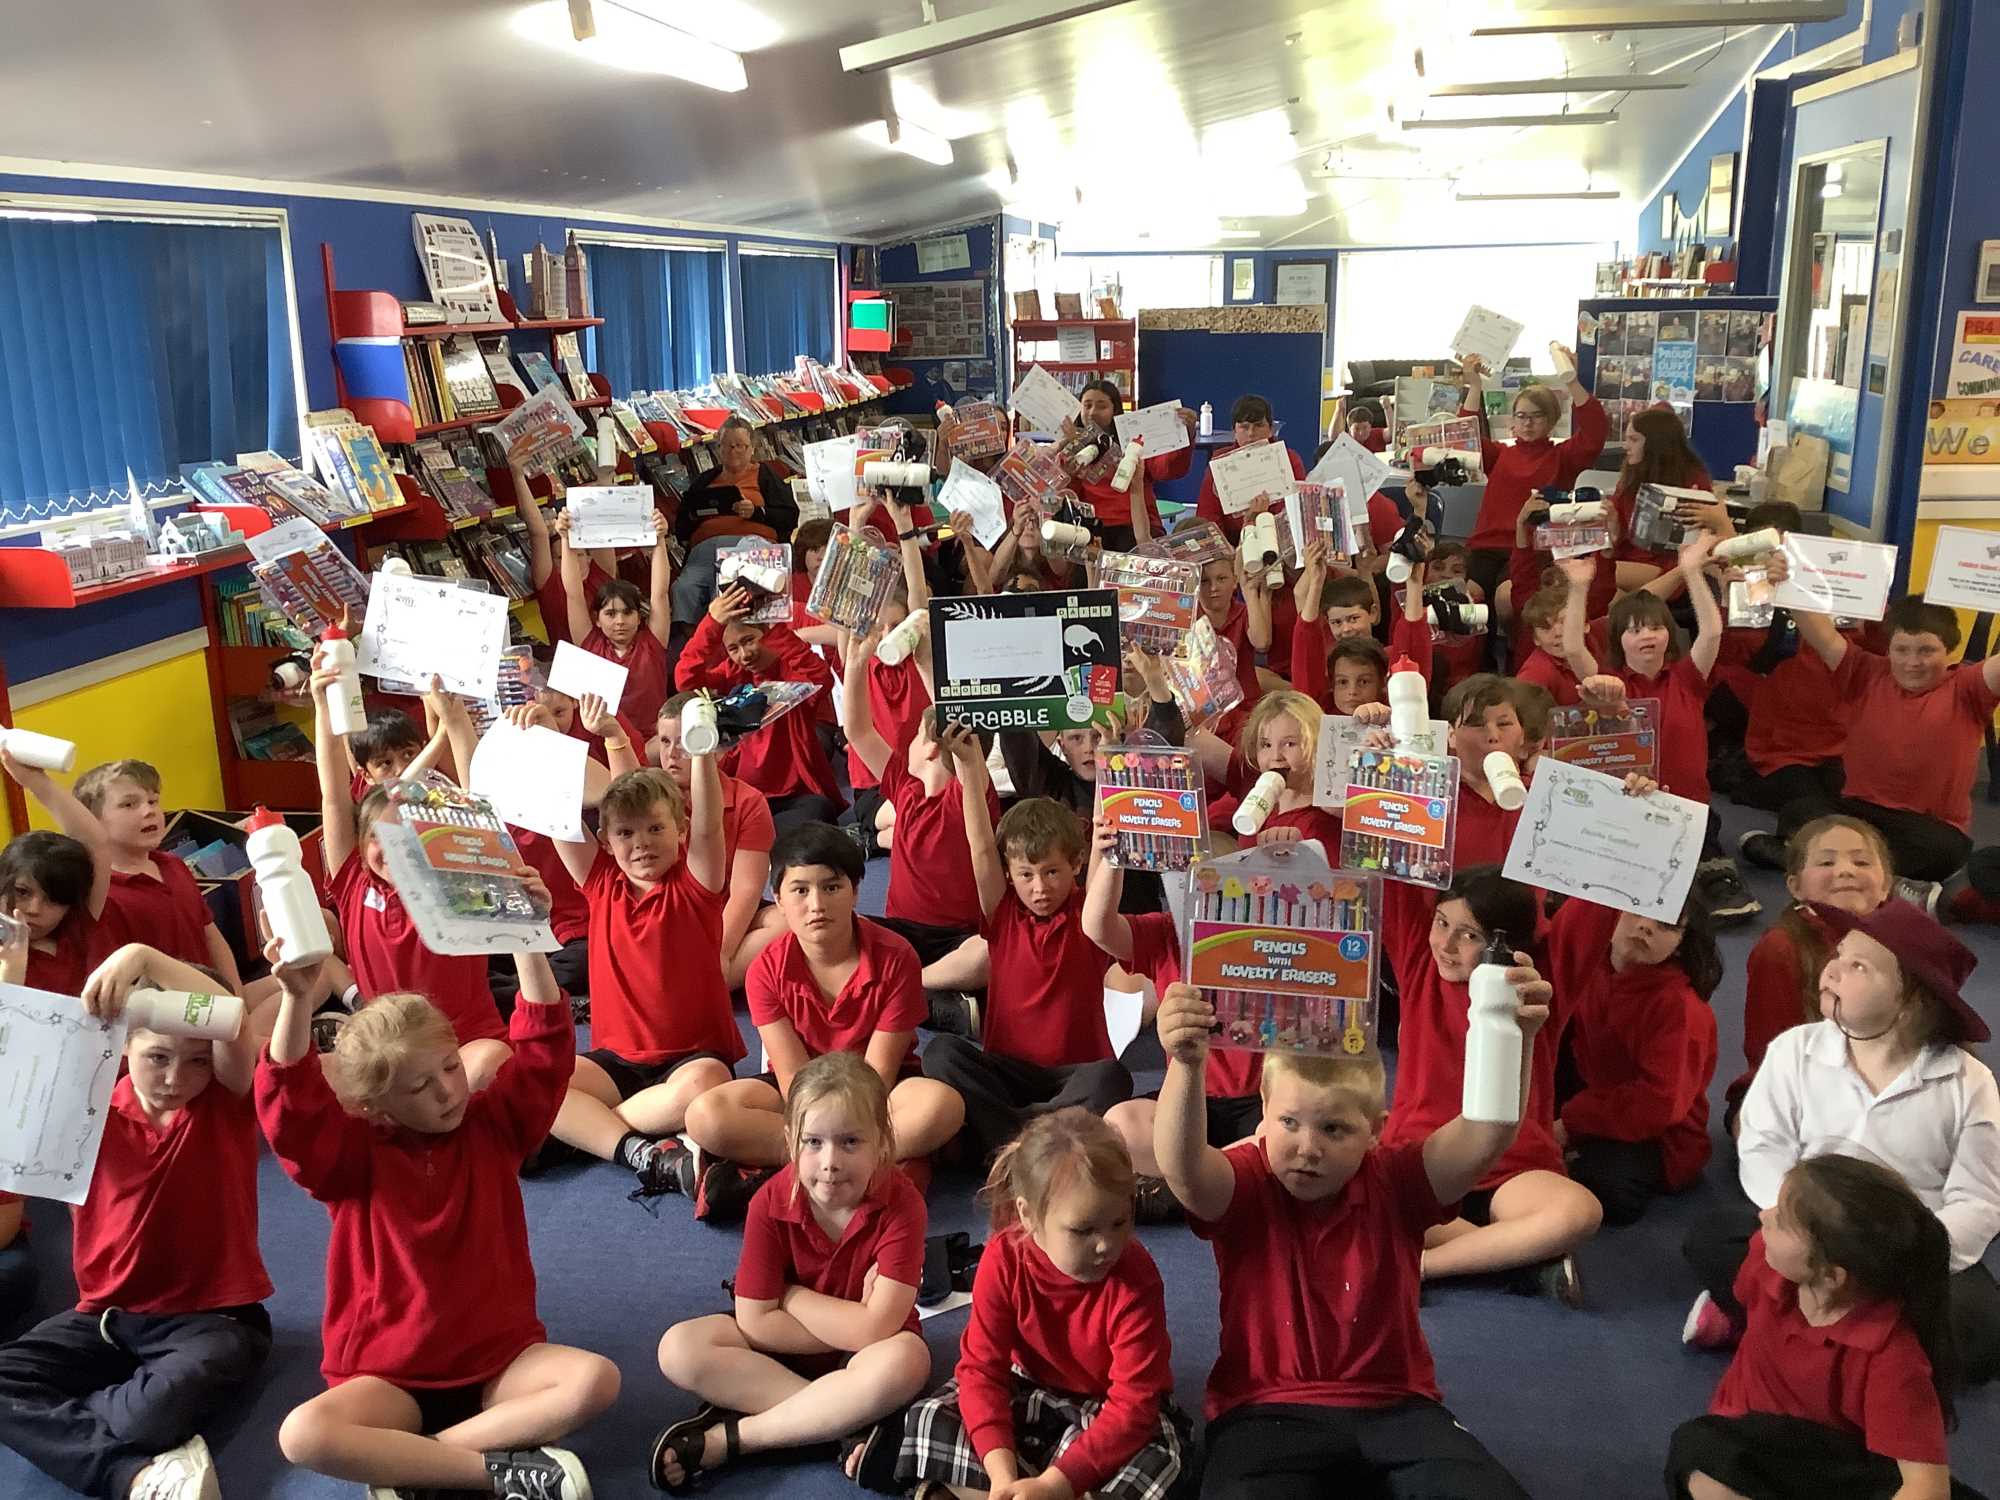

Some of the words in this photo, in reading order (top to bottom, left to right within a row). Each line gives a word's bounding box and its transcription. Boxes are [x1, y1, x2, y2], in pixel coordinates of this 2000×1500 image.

[1927, 427, 1990, 455] We
[1058, 606, 1111, 617] DAIRY
[942, 684, 1000, 696] CHOICE
[945, 703, 965, 713] KIWI
[945, 708, 1050, 730] SCRABBLE
[1133, 797, 1163, 808] PENCILS
[1253, 939, 1307, 955] PENCILS
[1346, 940, 1361, 952] 12
[1267, 956, 1292, 966] WITH
[1221, 963, 1279, 980] NOVELTY
[1281, 968, 1337, 986] ERASERS
